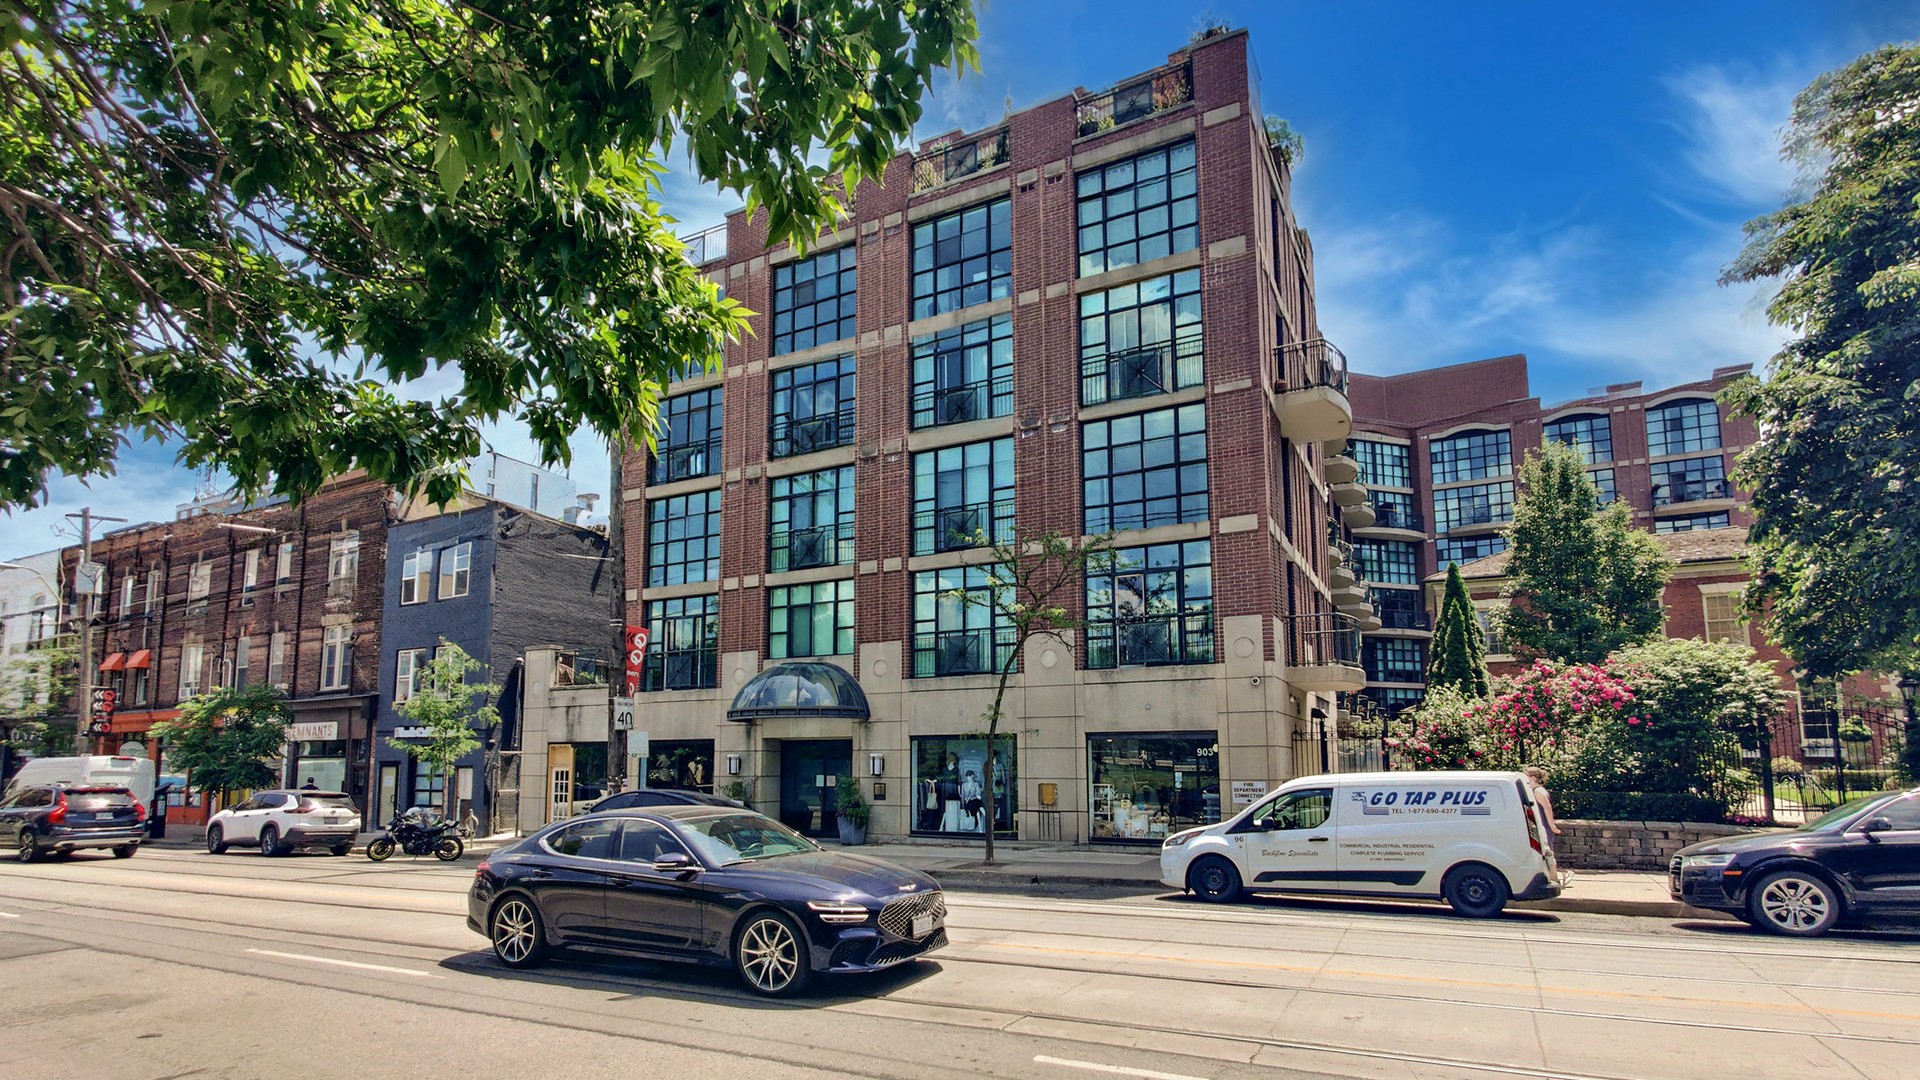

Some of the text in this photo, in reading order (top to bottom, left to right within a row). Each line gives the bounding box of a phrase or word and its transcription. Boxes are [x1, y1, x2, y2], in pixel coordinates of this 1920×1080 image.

[617, 711, 632, 725] 40
[1196, 748, 1214, 757] 903
[1370, 791, 1487, 805] GO TAP PLUS
[1234, 835, 1244, 843] 96
[1287, 849, 1319, 857] Specialists
